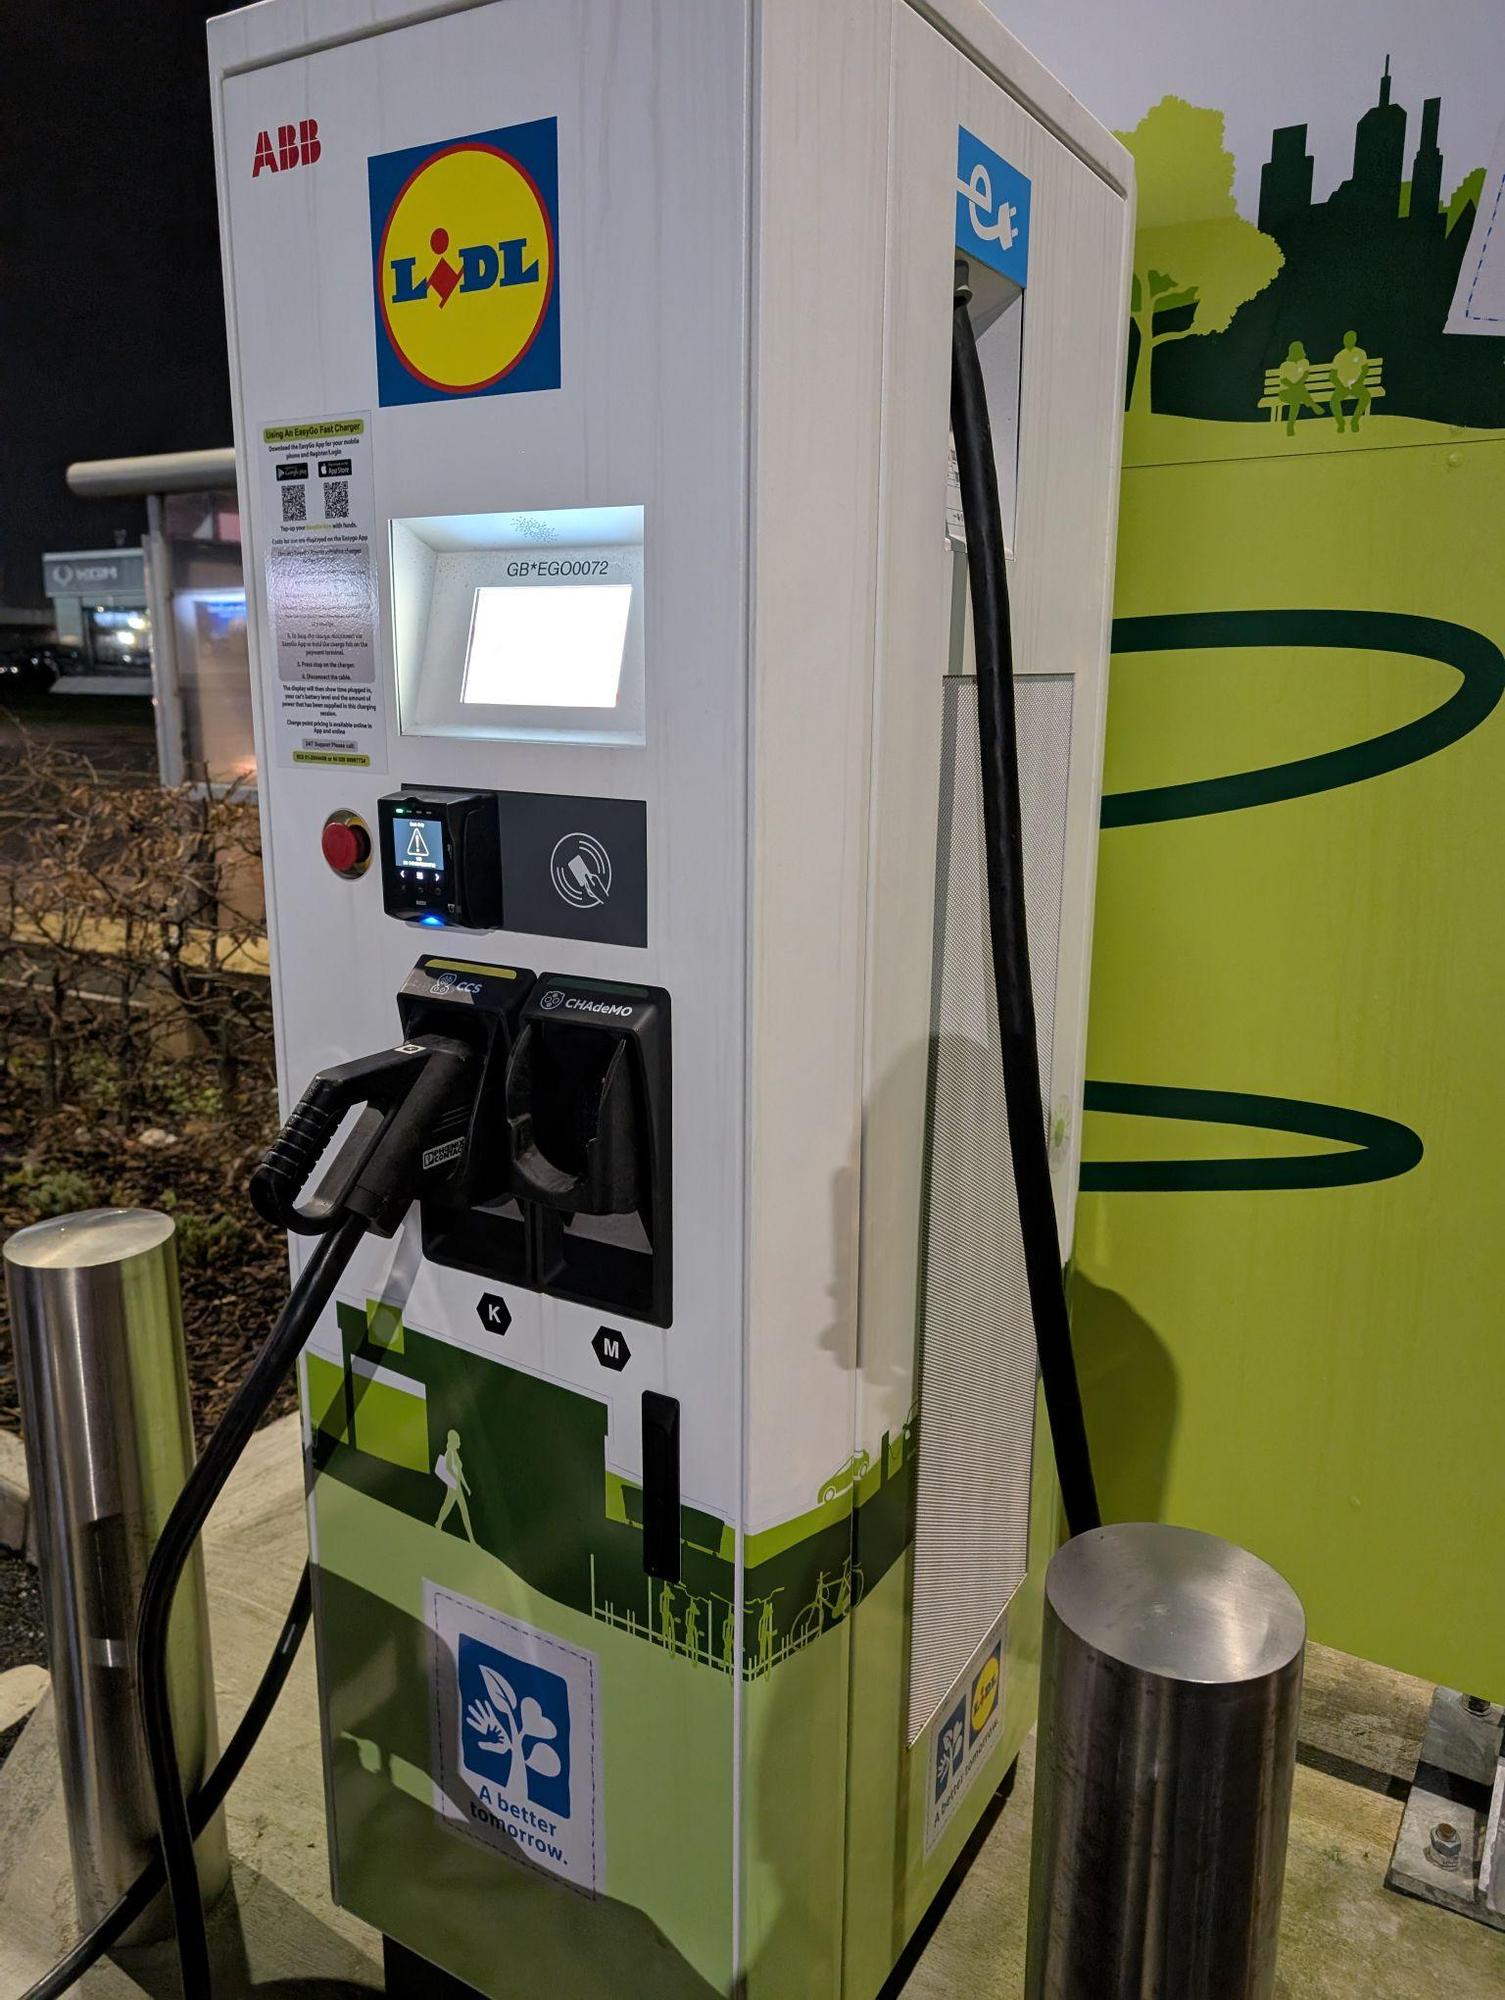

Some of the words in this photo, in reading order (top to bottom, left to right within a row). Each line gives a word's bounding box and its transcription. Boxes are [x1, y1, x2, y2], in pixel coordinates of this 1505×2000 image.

[252, 118, 322, 178] ABB
[265, 430, 284, 440] Using
[285, 429, 294, 437] An
[295, 426, 319, 438] EasyGo
[320, 424, 334, 434] Fast
[335, 422, 360, 434] Charger
[268, 443, 290, 452] Download
[316, 441, 325, 449] App
[332, 439, 343, 448] your
[344, 437, 360, 445] mobile
[286, 451, 300, 460] phone
[358, 533, 368, 542] App
[306, 649, 324, 657] payment
[306, 672, 330, 680] Disconnect
[291, 685, 306, 693] display
[347, 686, 366, 695] plugged
[285, 694, 294, 702] your
[304, 694, 321, 702] battery
[282, 701, 295, 709] power
[323, 702, 343, 710] supplied
[356, 703, 376, 712] charging
[287, 719, 302, 728] Charge
[302, 720, 314, 728] point
[313, 720, 329, 729] pricing
[331, 741, 346, 749] Please
[456, 981, 483, 994] CCS
[565, 997, 633, 1018] CHAdeMO
[488, 1303, 501, 1324] K
[603, 1337, 620, 1360] M
[941, 1775, 963, 1814] better
[479, 1784, 493, 1802] A
[497, 1790, 557, 1838] better
[470, 1801, 569, 1866] tomorrow.
